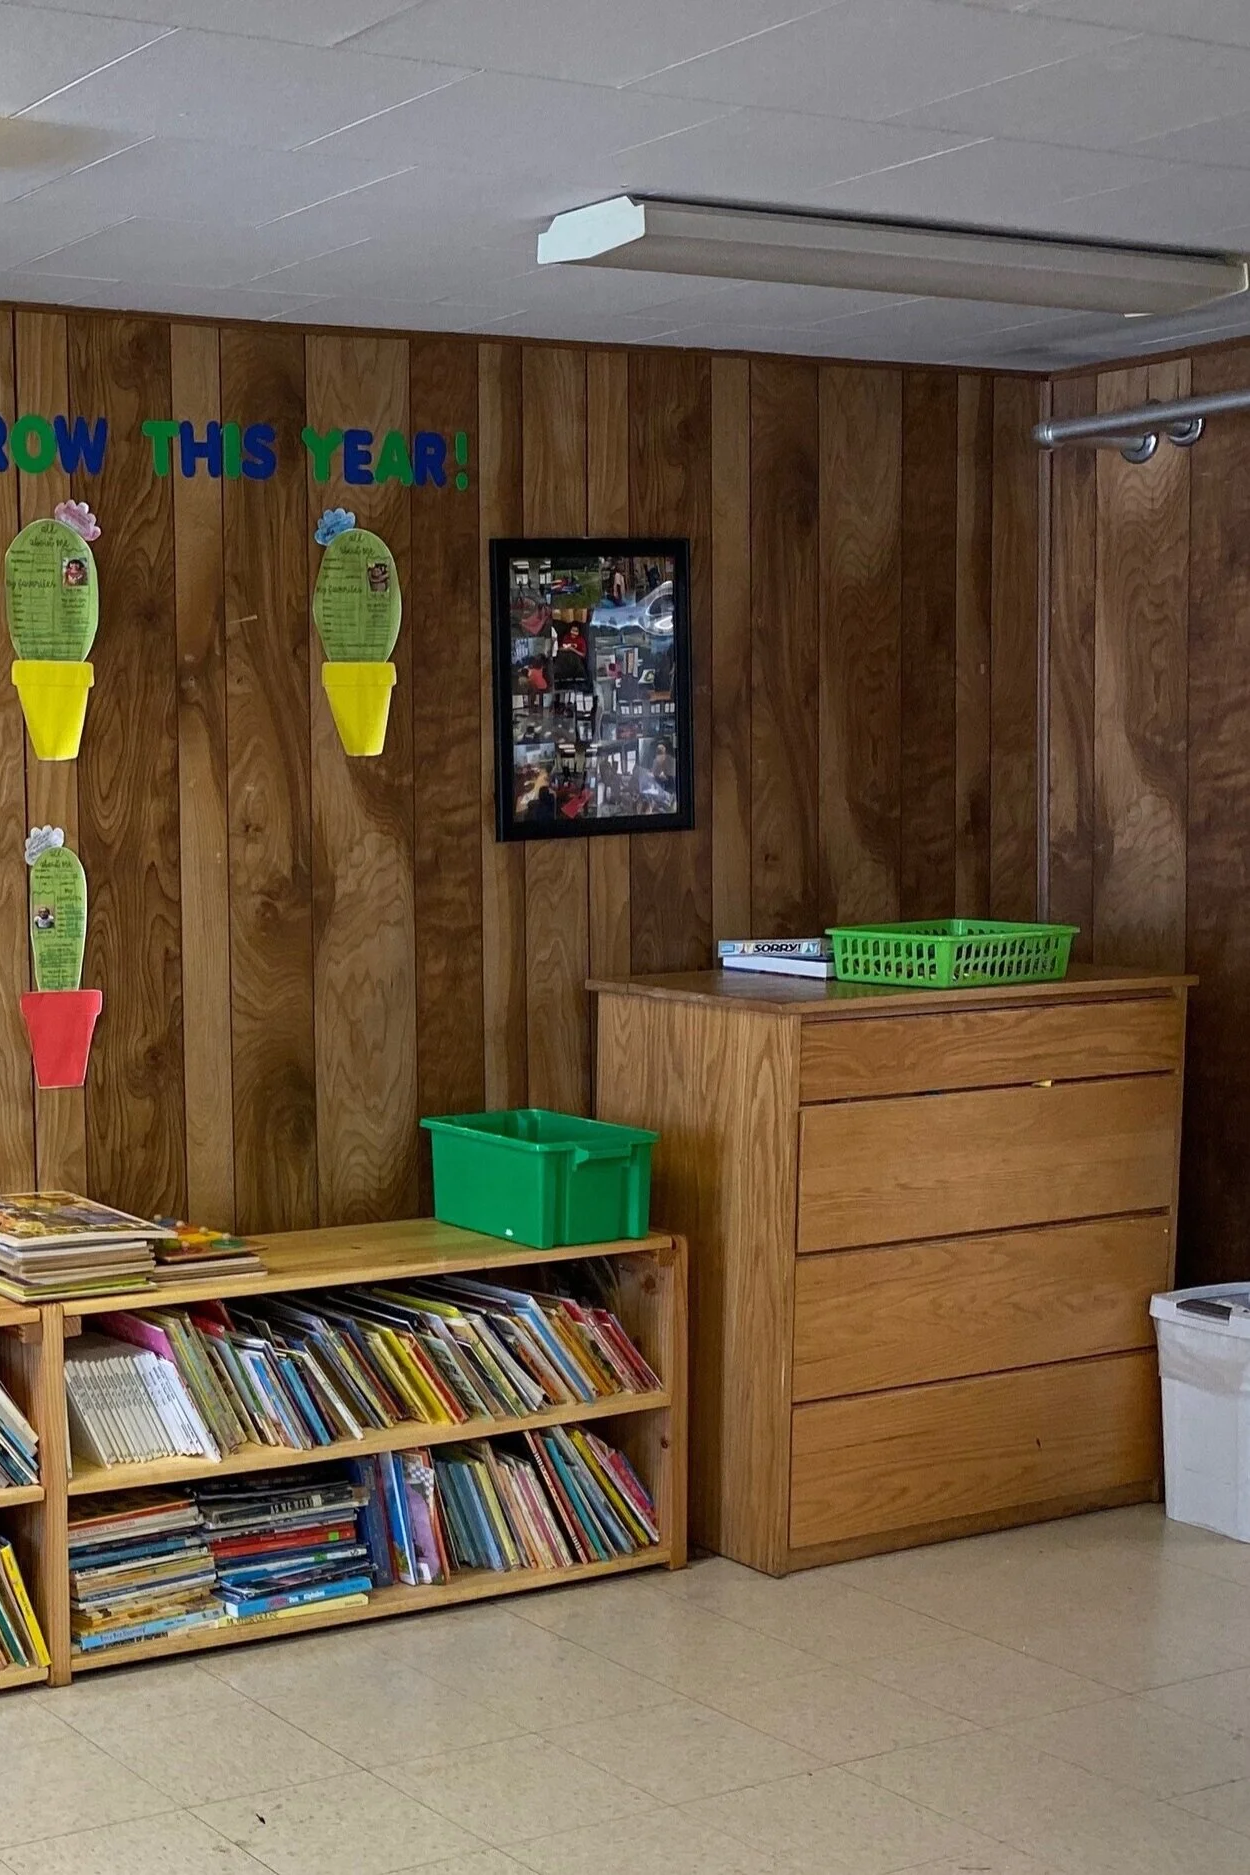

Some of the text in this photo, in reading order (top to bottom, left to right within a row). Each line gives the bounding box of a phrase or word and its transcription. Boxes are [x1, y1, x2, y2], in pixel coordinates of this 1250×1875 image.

[141, 419, 277, 481] THIS
[301, 425, 469, 491] YEAR!
[754, 943, 801, 953] SORRY!
